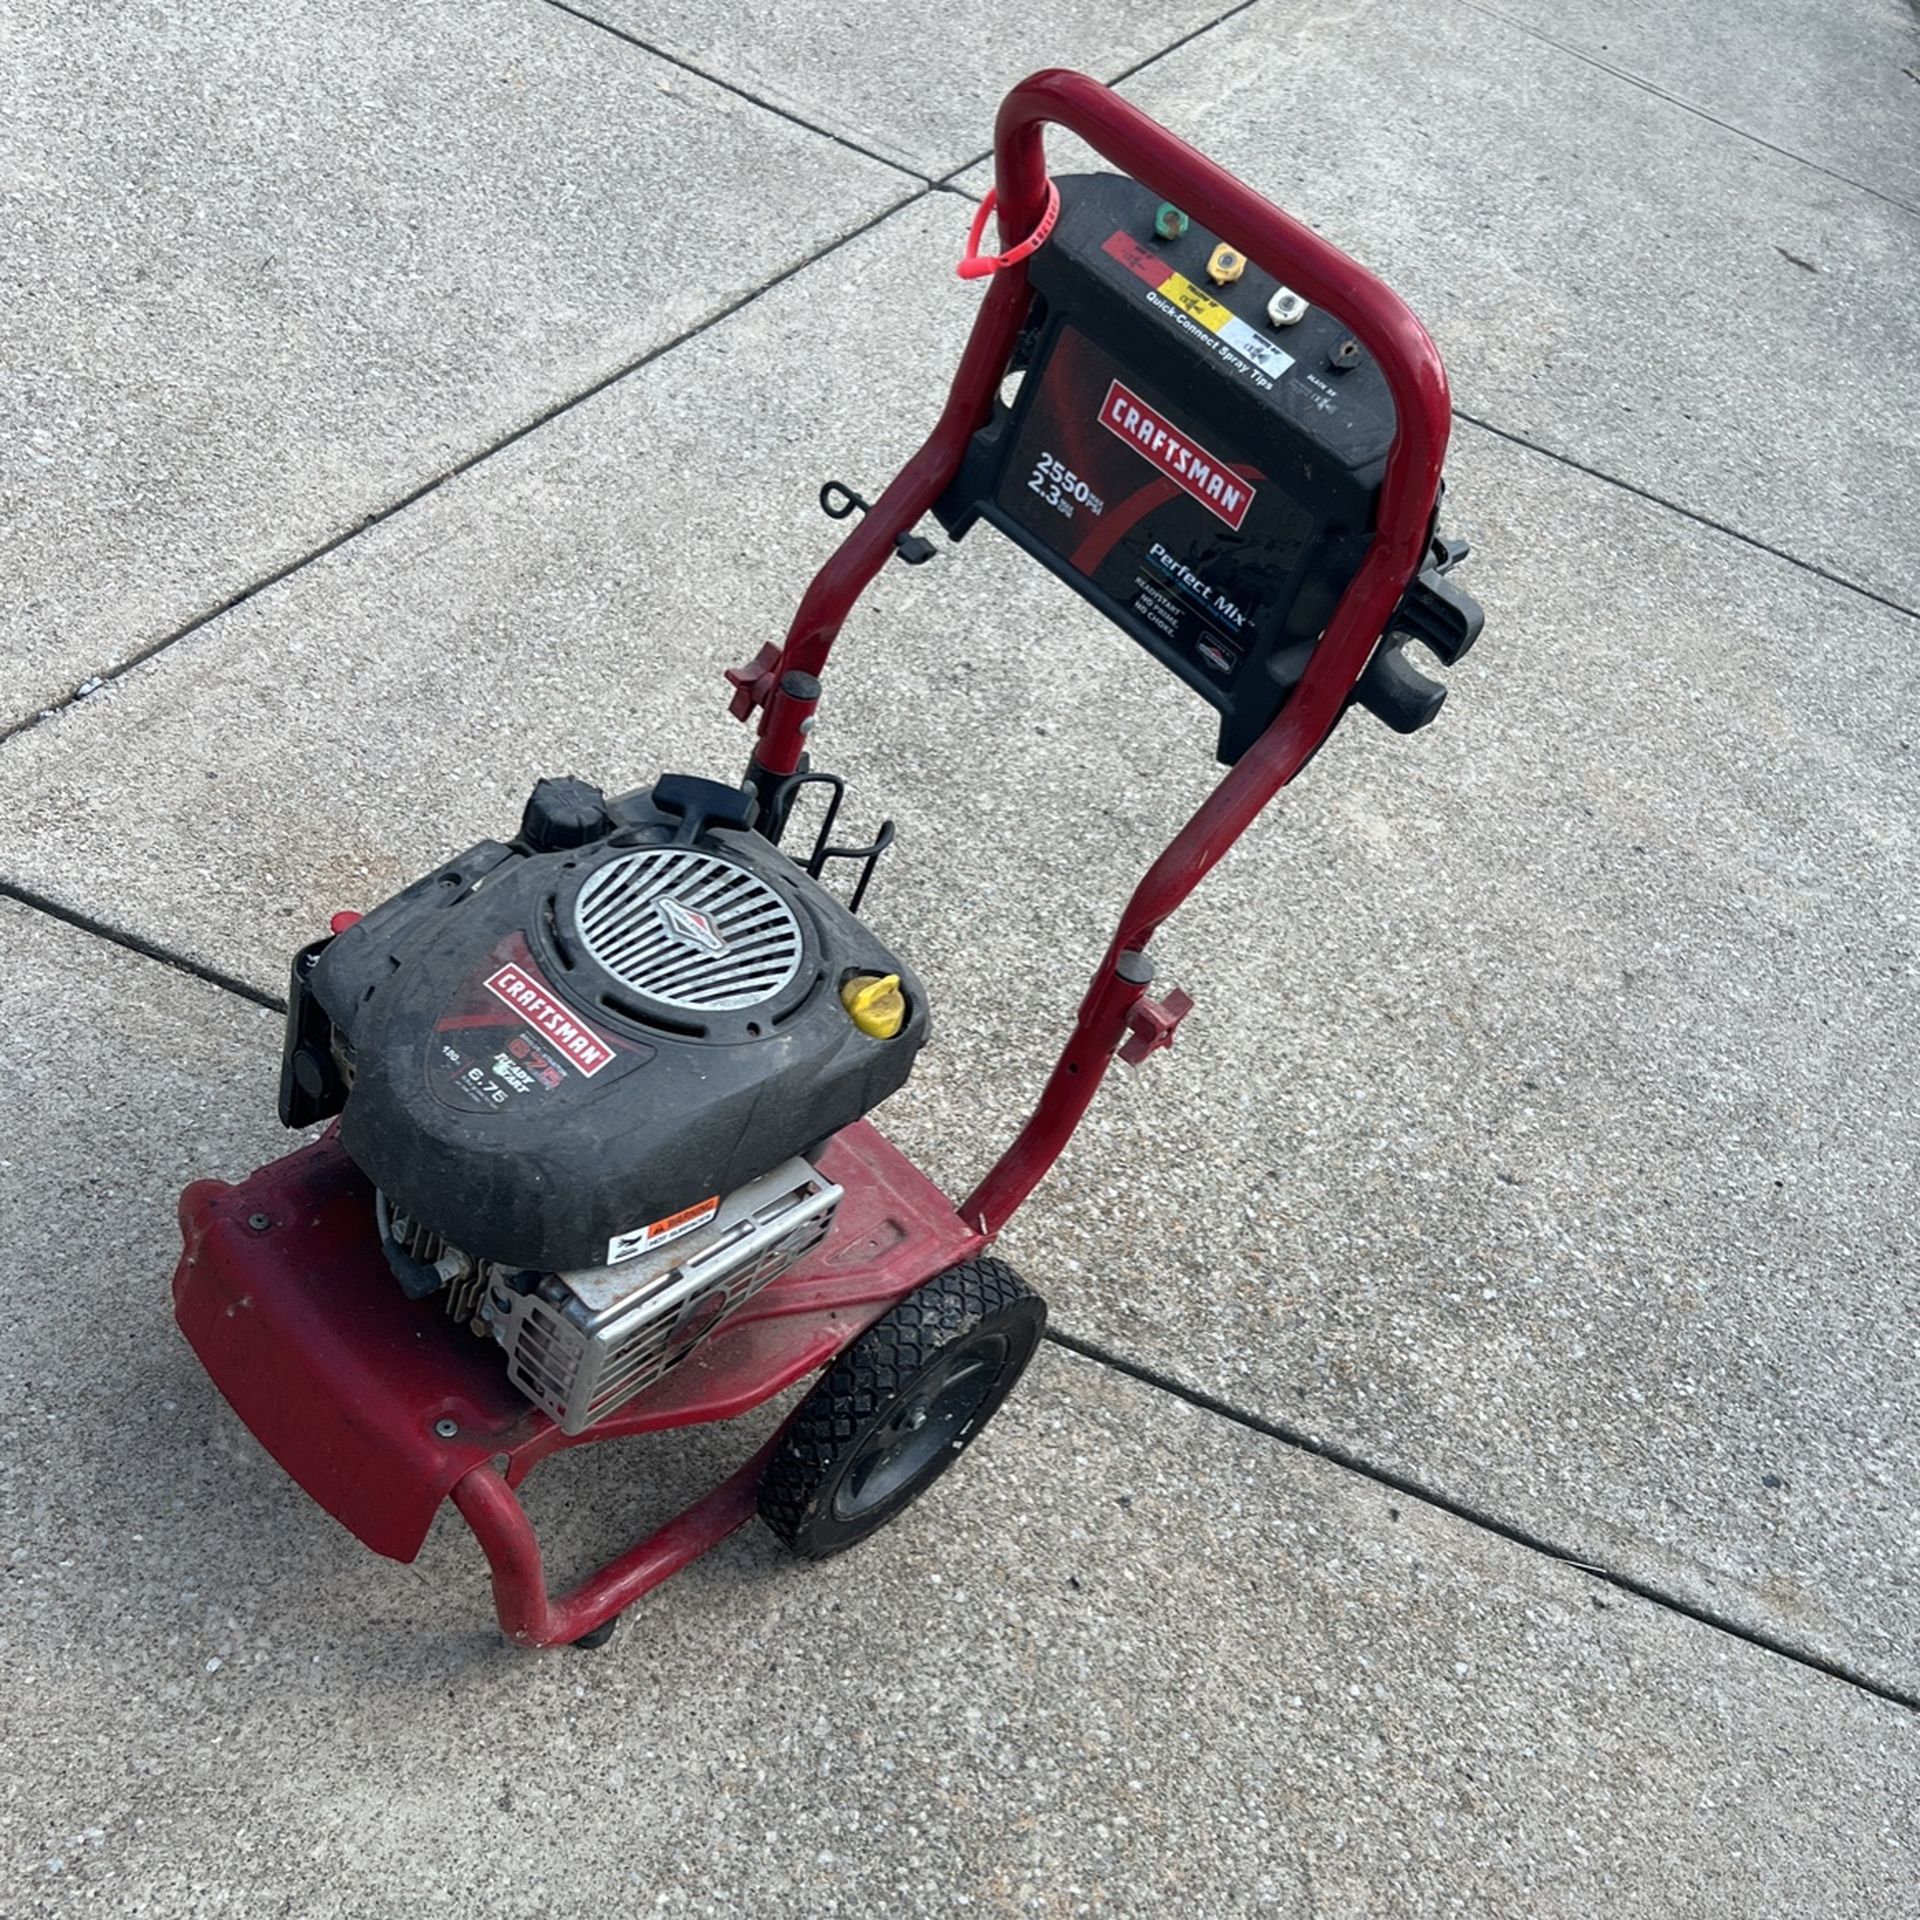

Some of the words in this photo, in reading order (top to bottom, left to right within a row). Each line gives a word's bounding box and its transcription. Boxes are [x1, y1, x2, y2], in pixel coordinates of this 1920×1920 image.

[1145, 291, 1220, 351] Quick-Connect
[1218, 343, 1251, 374] Spray
[1250, 367, 1274, 392] Tips
[1036, 452, 1090, 502] 2550
[1110, 397, 1243, 513] CRAFTSMAN
[1027, 470, 1061, 506] 2.3
[1149, 542, 1213, 600] Perfect
[497, 973, 602, 1066] CRAFTSMAN
[493, 1052, 536, 1084] READY
